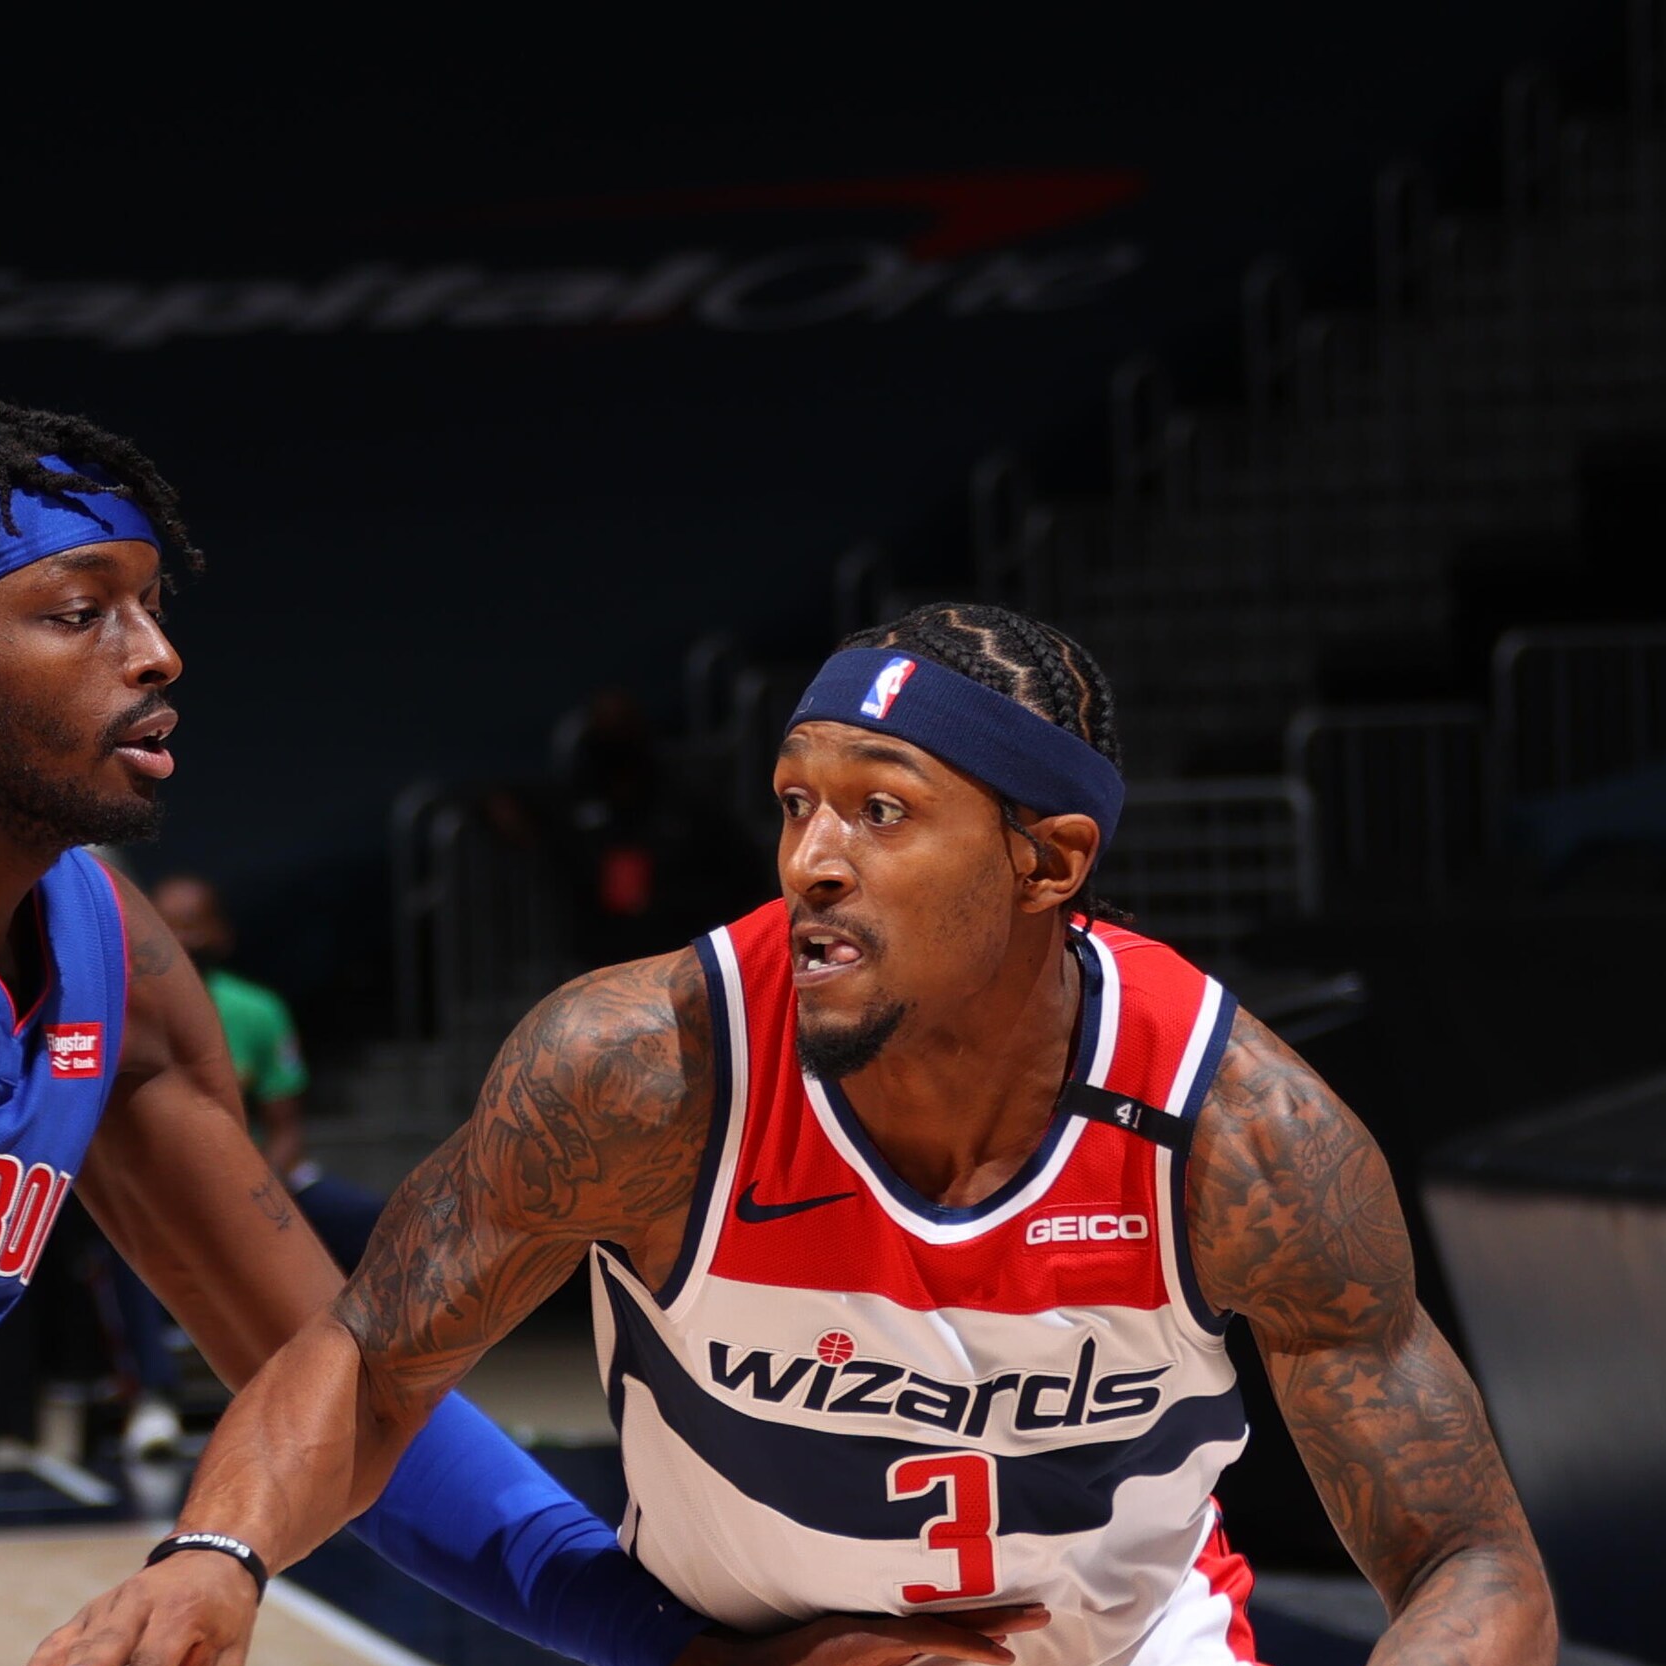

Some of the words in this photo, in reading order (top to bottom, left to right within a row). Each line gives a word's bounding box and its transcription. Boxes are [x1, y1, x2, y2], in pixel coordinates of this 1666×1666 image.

[1116, 1102, 1143, 1130] 41
[1026, 1213, 1149, 1246] GEICO
[706, 1328, 1177, 1440] wizards
[887, 1451, 1000, 1608] 3
